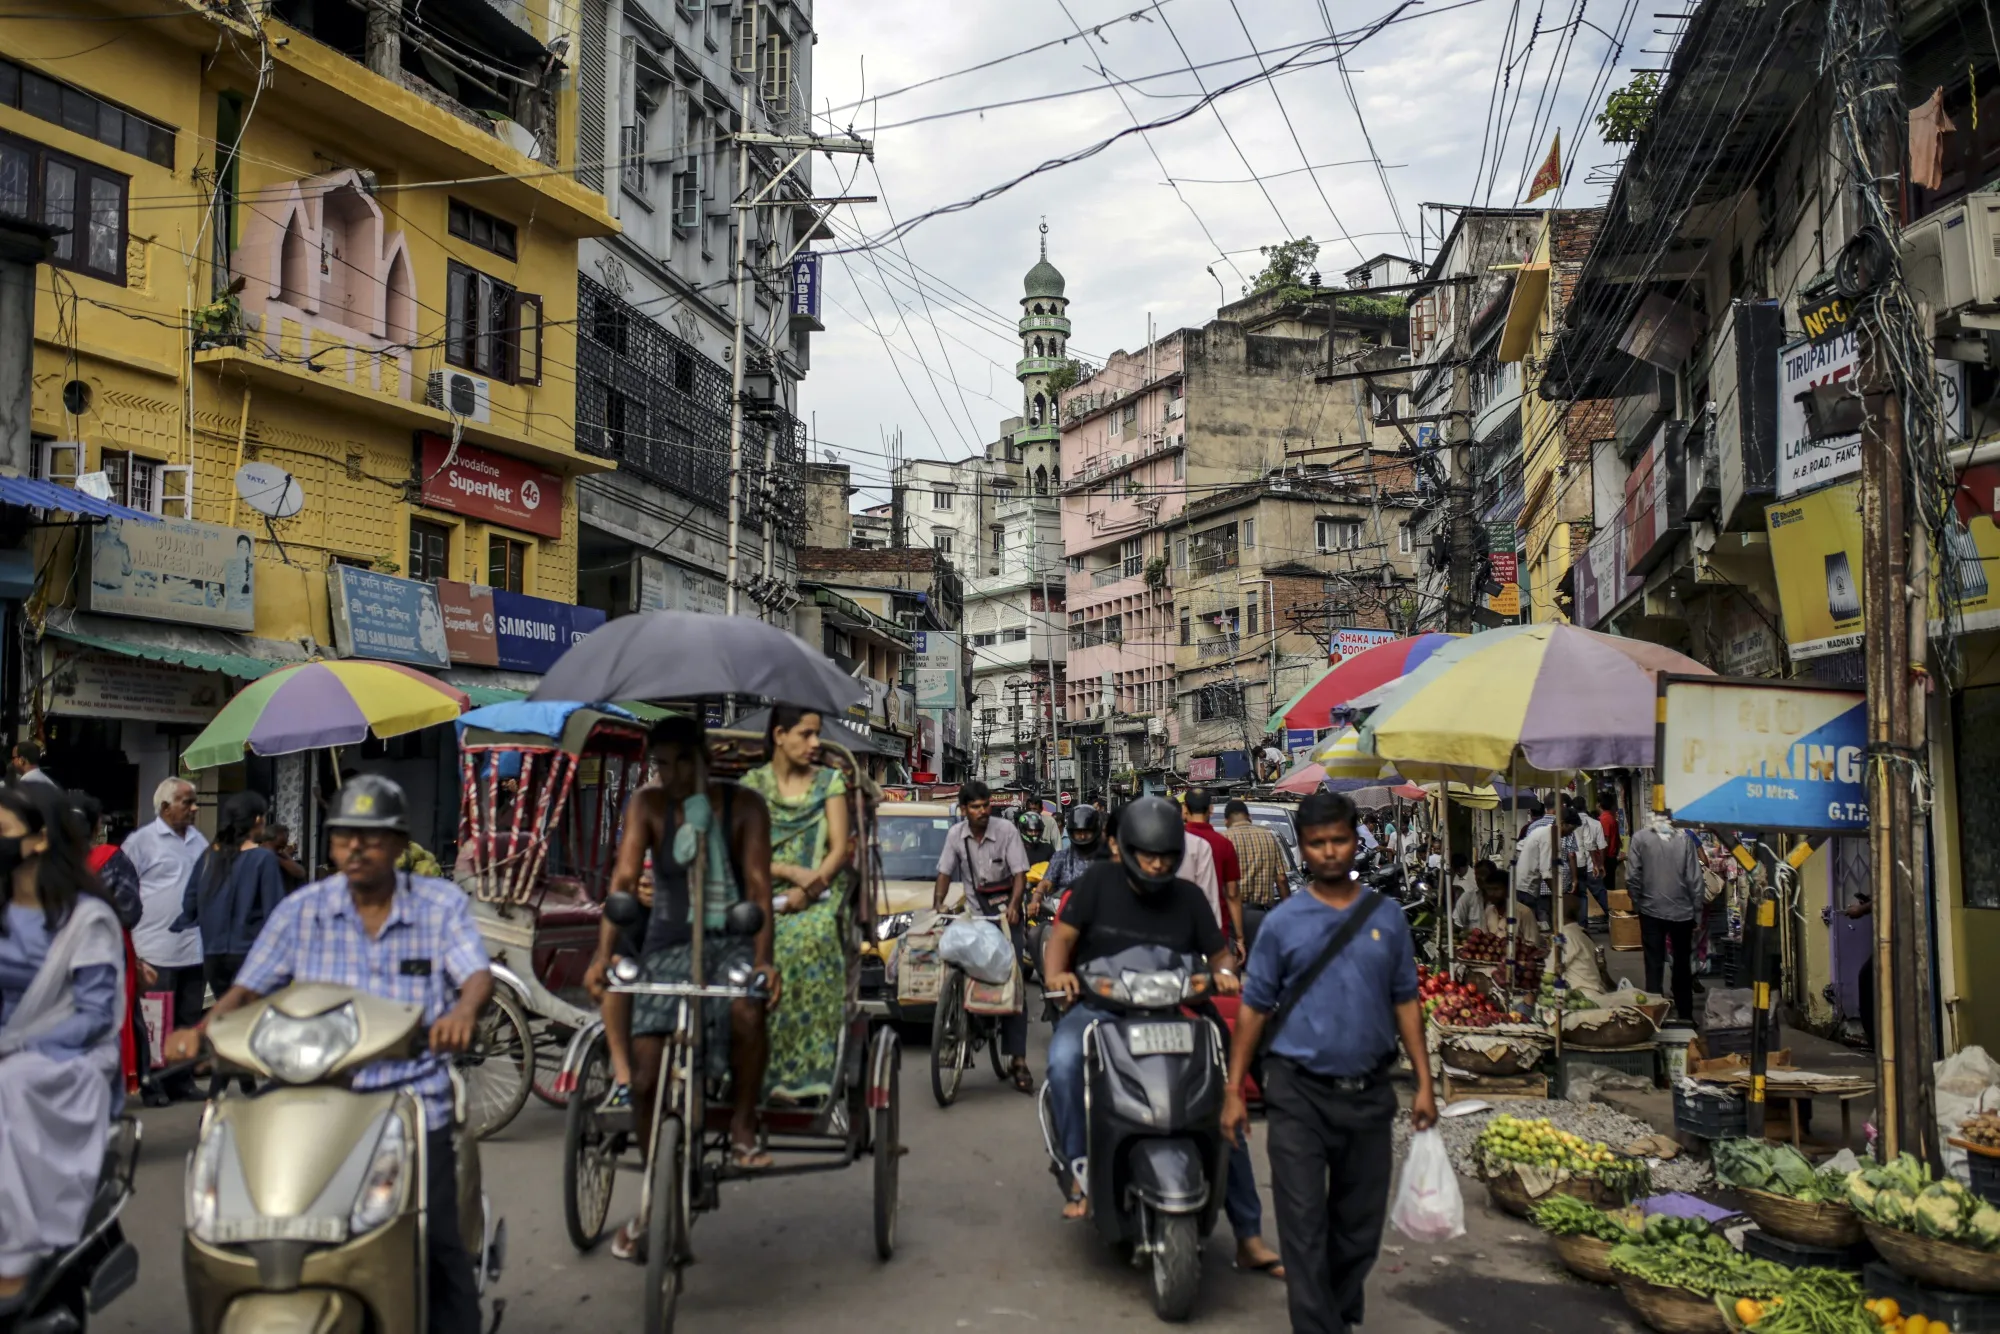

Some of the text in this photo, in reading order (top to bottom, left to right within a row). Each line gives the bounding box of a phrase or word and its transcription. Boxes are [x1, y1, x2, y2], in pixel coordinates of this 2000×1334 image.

[794, 253, 815, 262] HOTEL
[797, 263, 811, 314] AMBER
[1786, 338, 1837, 383] TIRUPATI
[1835, 443, 1862, 464] FANCY
[460, 457, 500, 478] vodafone
[246, 474, 267, 485] TATA
[524, 484, 538, 503] 4G
[707, 582, 727, 601] AMBE
[354, 628, 368, 643] SRI
[369, 630, 387, 646] SANI
[499, 615, 556, 642] SAMSUNG
[1340, 632, 1369, 644] SHAKA
[1826, 636, 1855, 650] MADHAV
[1683, 736, 1862, 784] PARKING
[1746, 782, 1800, 801] 50 Mtrs.
